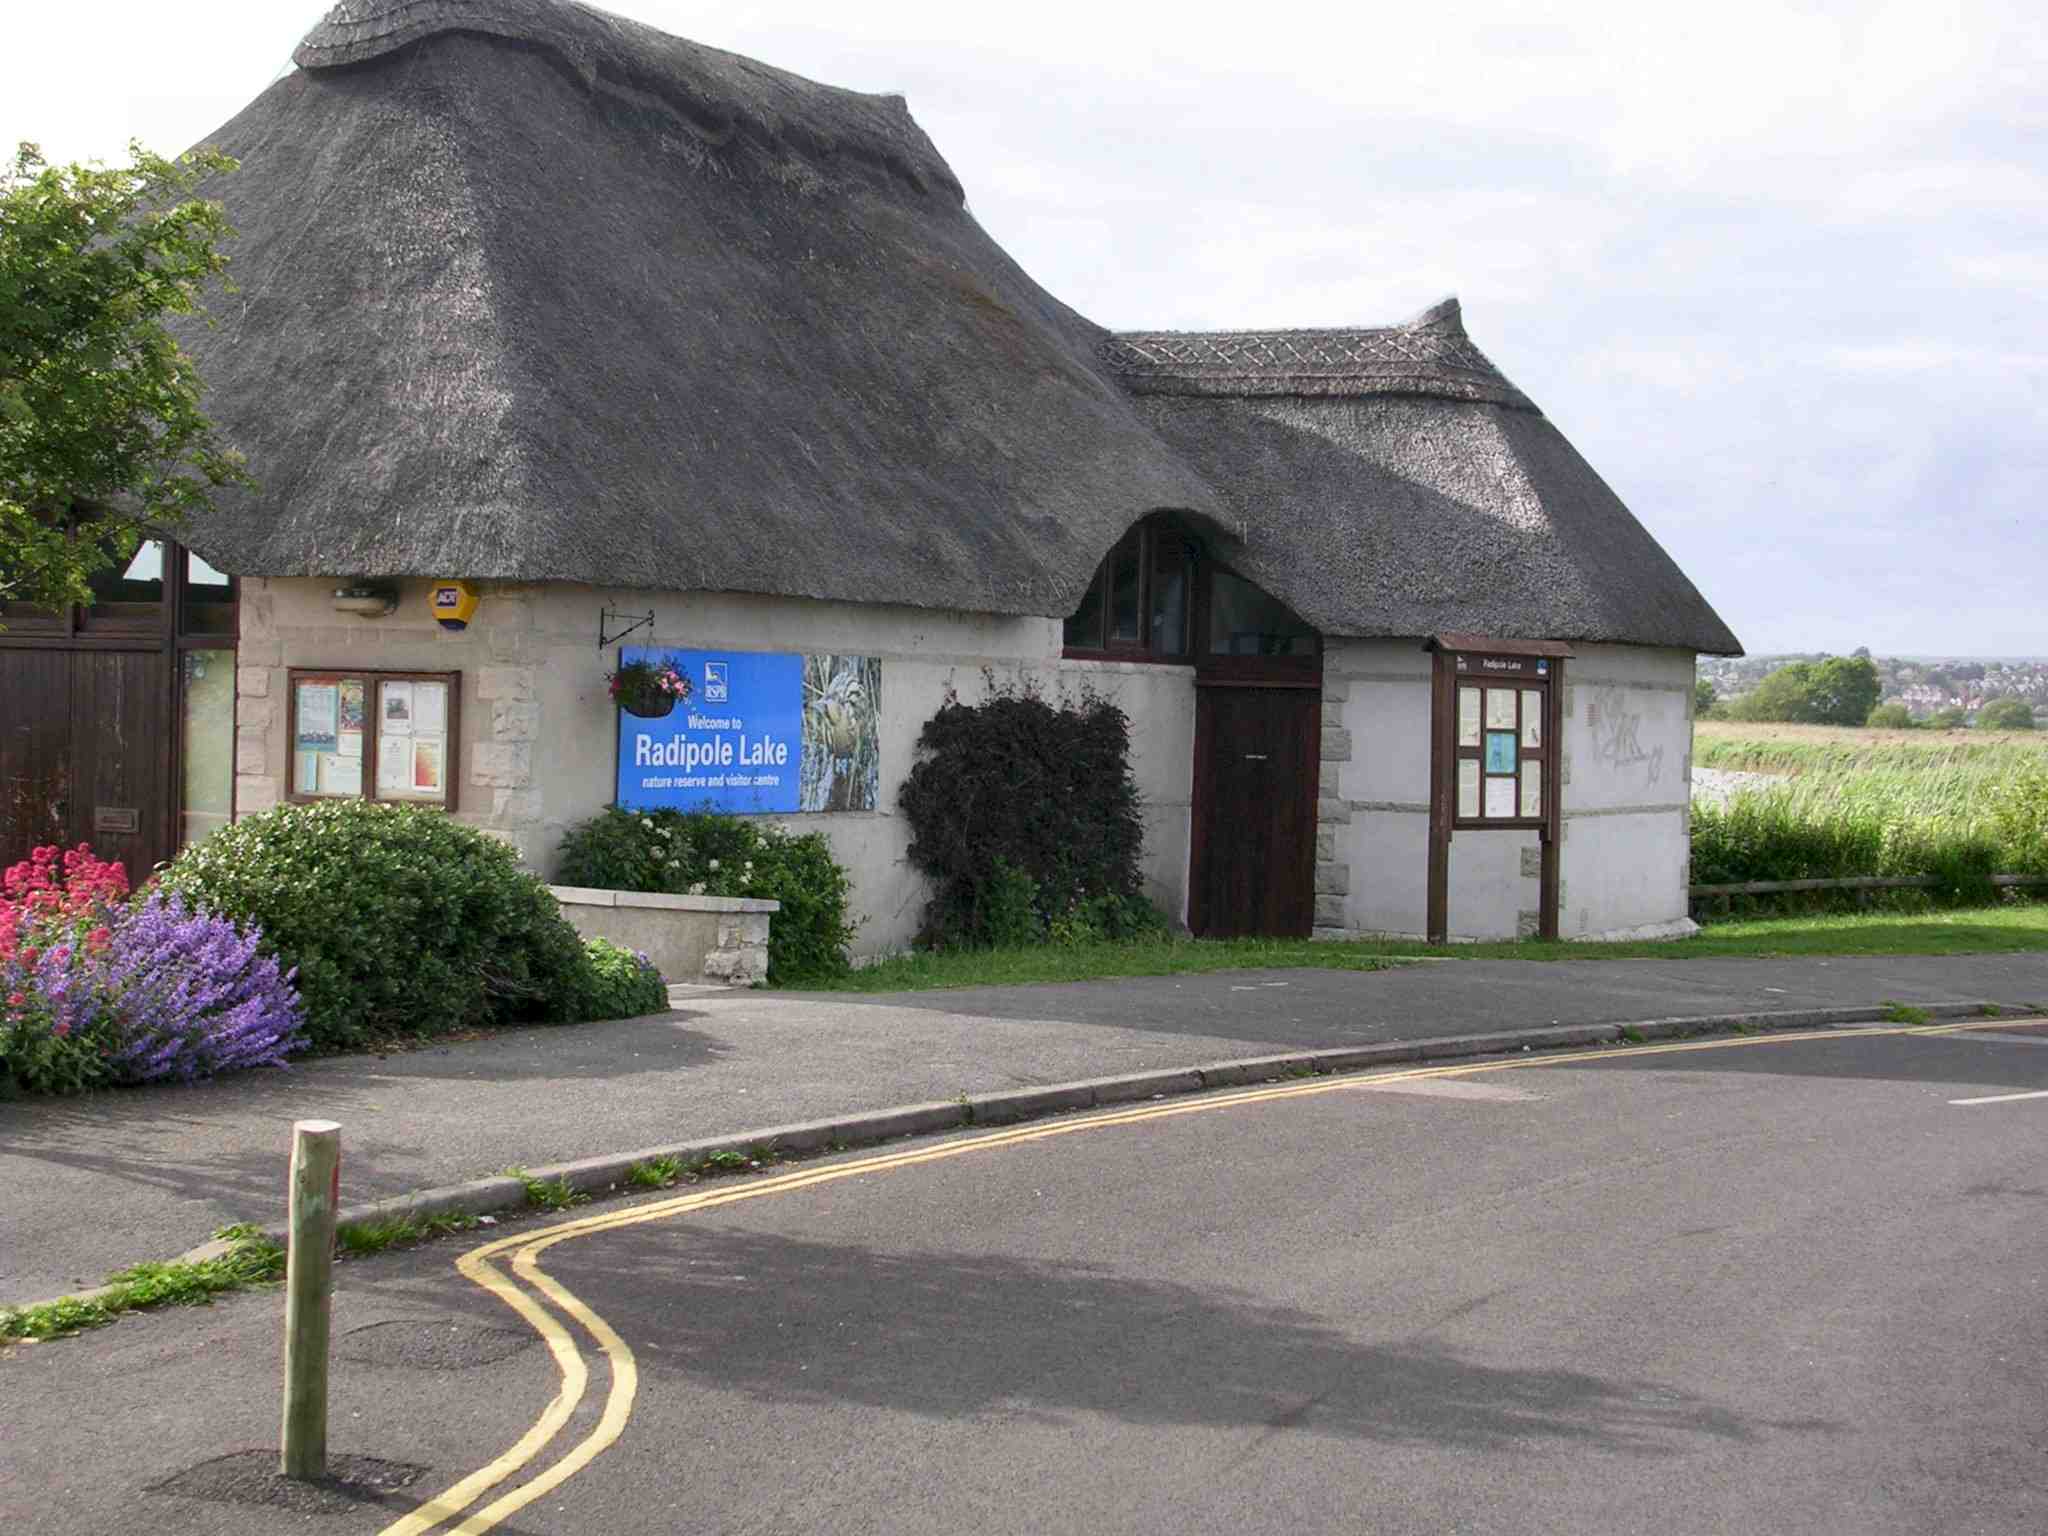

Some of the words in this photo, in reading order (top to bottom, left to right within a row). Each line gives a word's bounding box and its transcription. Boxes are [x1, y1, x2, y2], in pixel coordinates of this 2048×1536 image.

[687, 714, 730, 730] Welcome
[731, 716, 742, 730] to
[636, 733, 733, 773] Radipole
[739, 735, 788, 766] Lake
[642, 775, 673, 788] nature
[674, 777, 706, 788] reserve
[708, 774, 725, 787] and
[726, 774, 751, 786] visitor
[753, 774, 780, 786] centre
